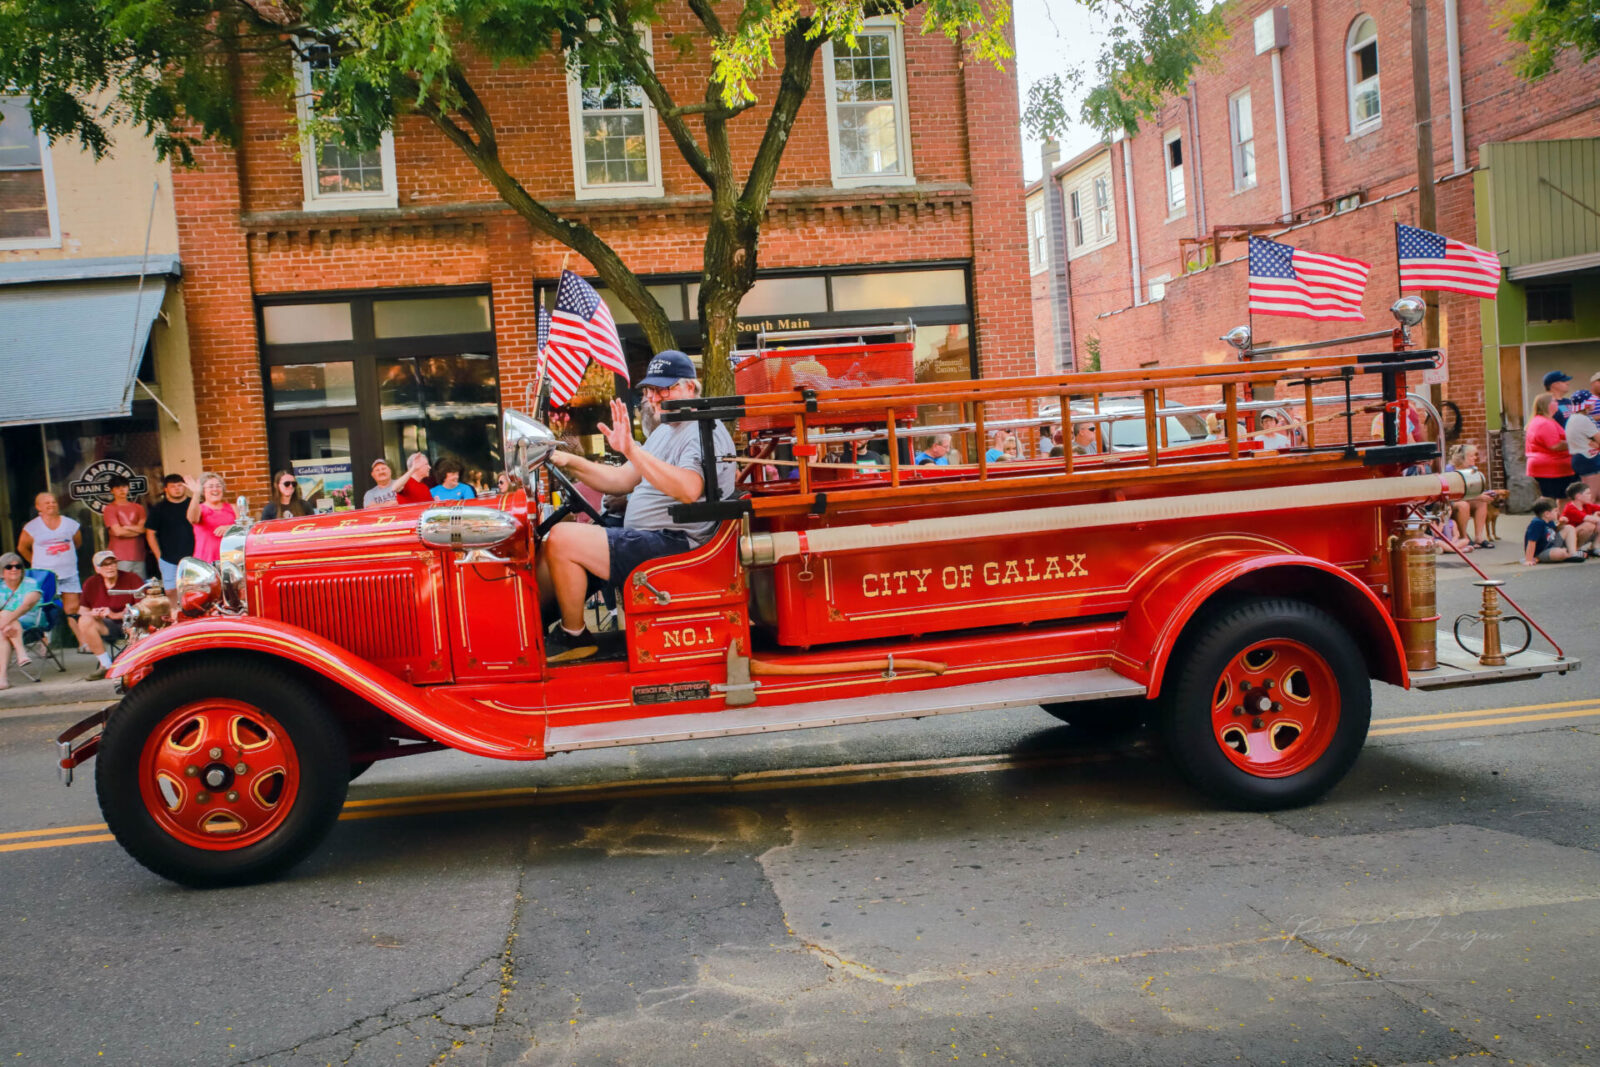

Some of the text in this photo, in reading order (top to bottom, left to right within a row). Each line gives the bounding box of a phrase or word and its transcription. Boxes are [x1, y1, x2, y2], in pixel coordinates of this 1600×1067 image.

[736, 318, 810, 332] South Main
[84, 463, 131, 483] BARBER
[298, 465, 347, 475] Galax, Virginia
[75, 481, 142, 494] MAIN SET
[862, 553, 1089, 598] CITY OF GALAX
